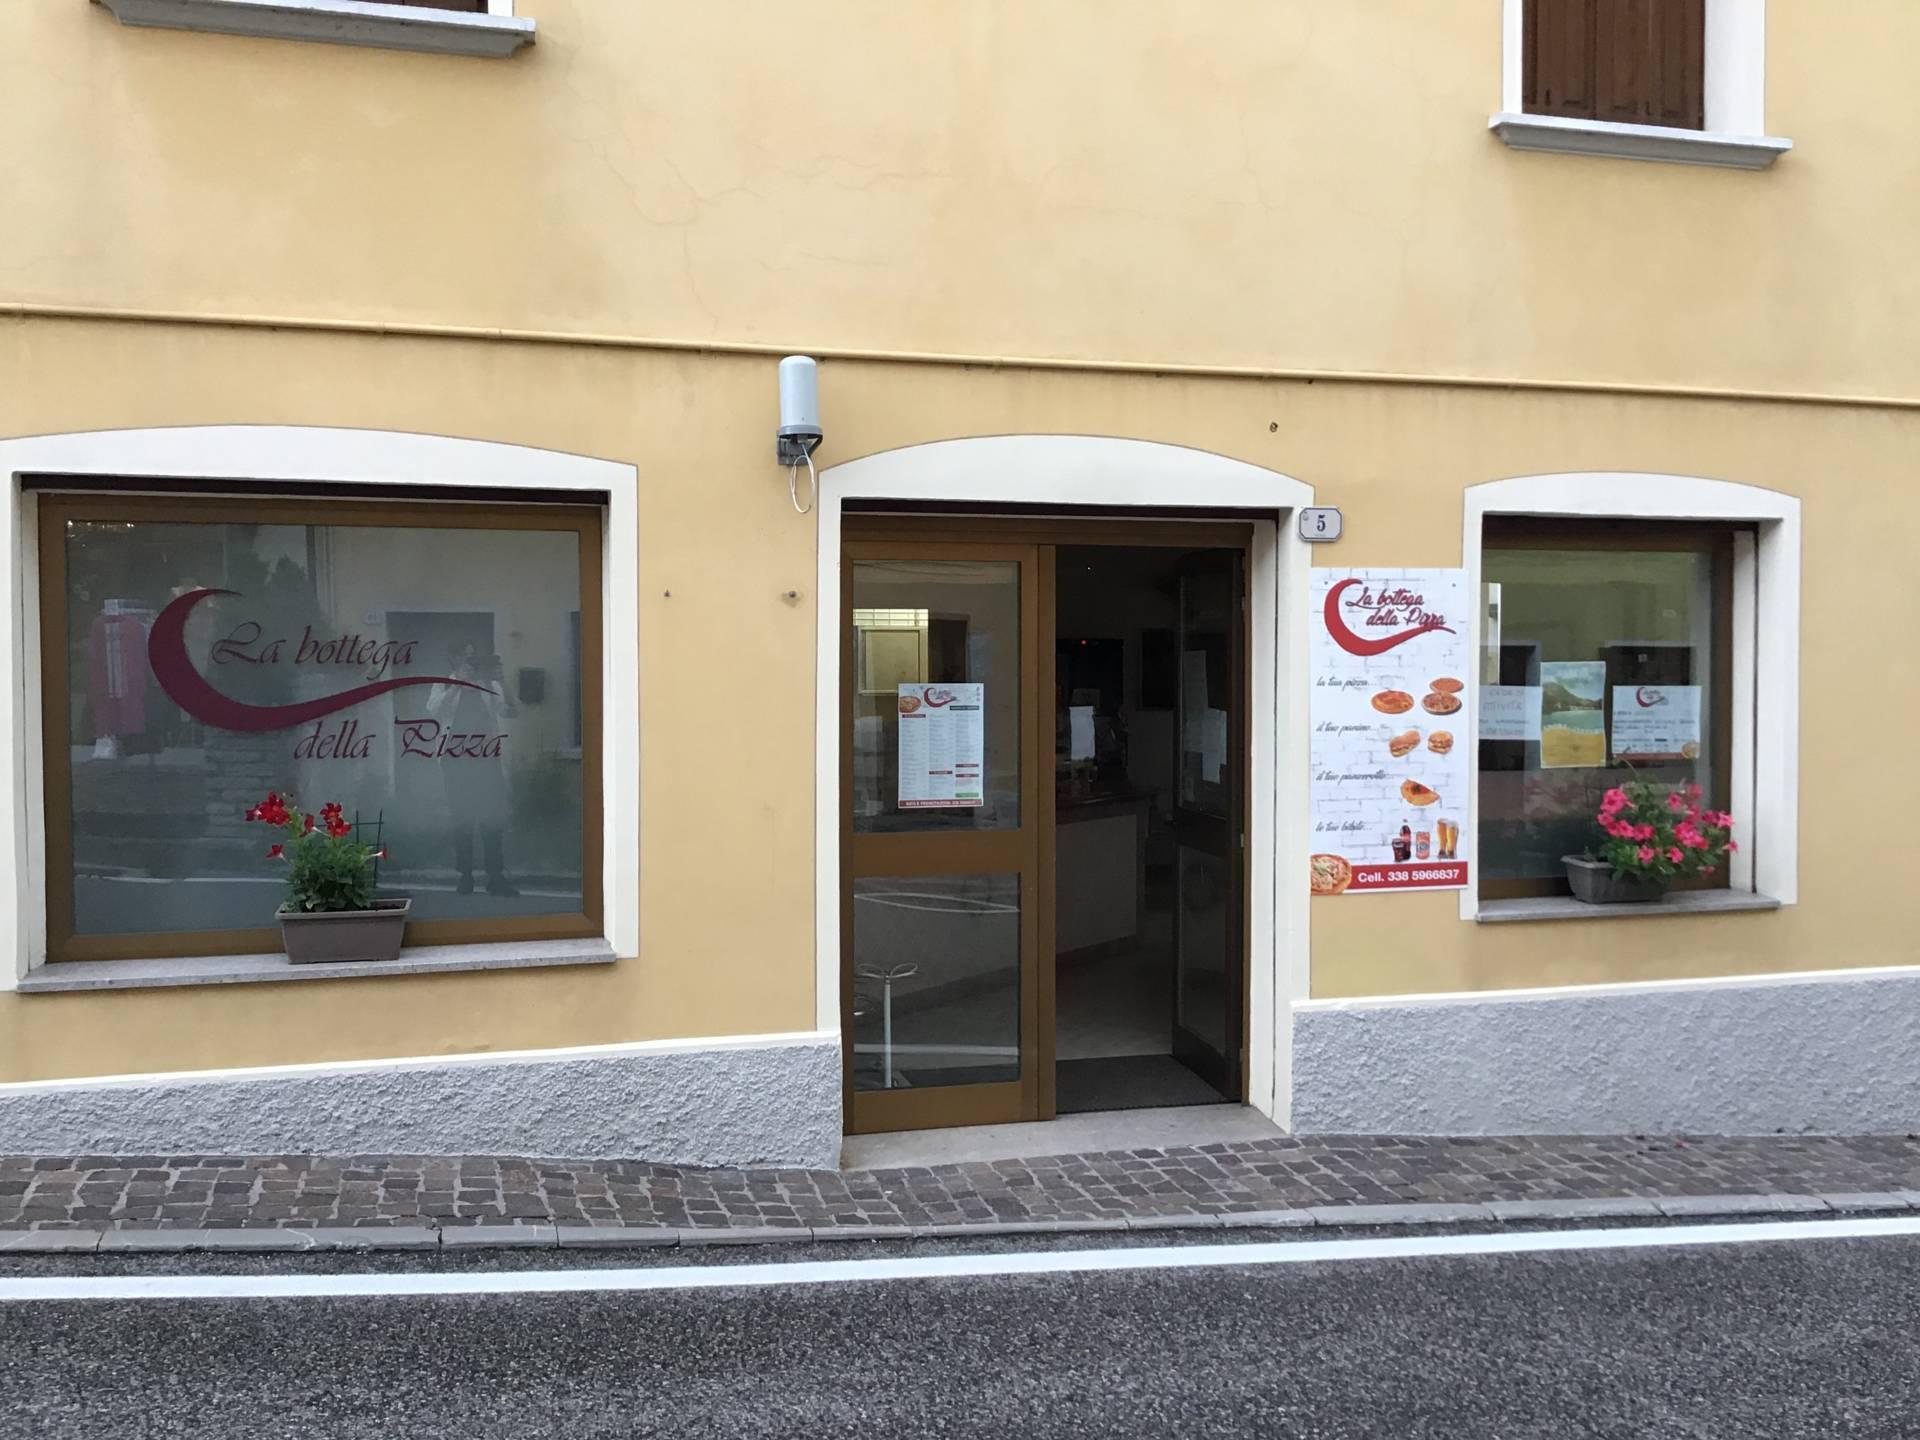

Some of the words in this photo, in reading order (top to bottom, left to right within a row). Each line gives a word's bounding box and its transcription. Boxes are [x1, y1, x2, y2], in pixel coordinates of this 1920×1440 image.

[1317, 514, 1326, 532] 5
[1345, 586, 1375, 609] La
[1377, 588, 1424, 612] bottega
[1366, 608, 1400, 626] della
[1403, 607, 1446, 630] Pizza
[212, 622, 286, 665] La
[295, 625, 419, 681] bottega
[293, 720, 376, 759] della
[394, 716, 508, 759] Pizza
[1358, 871, 1385, 883] Cell.
[1387, 871, 1409, 882] 338
[1412, 868, 1460, 881] 5966837
